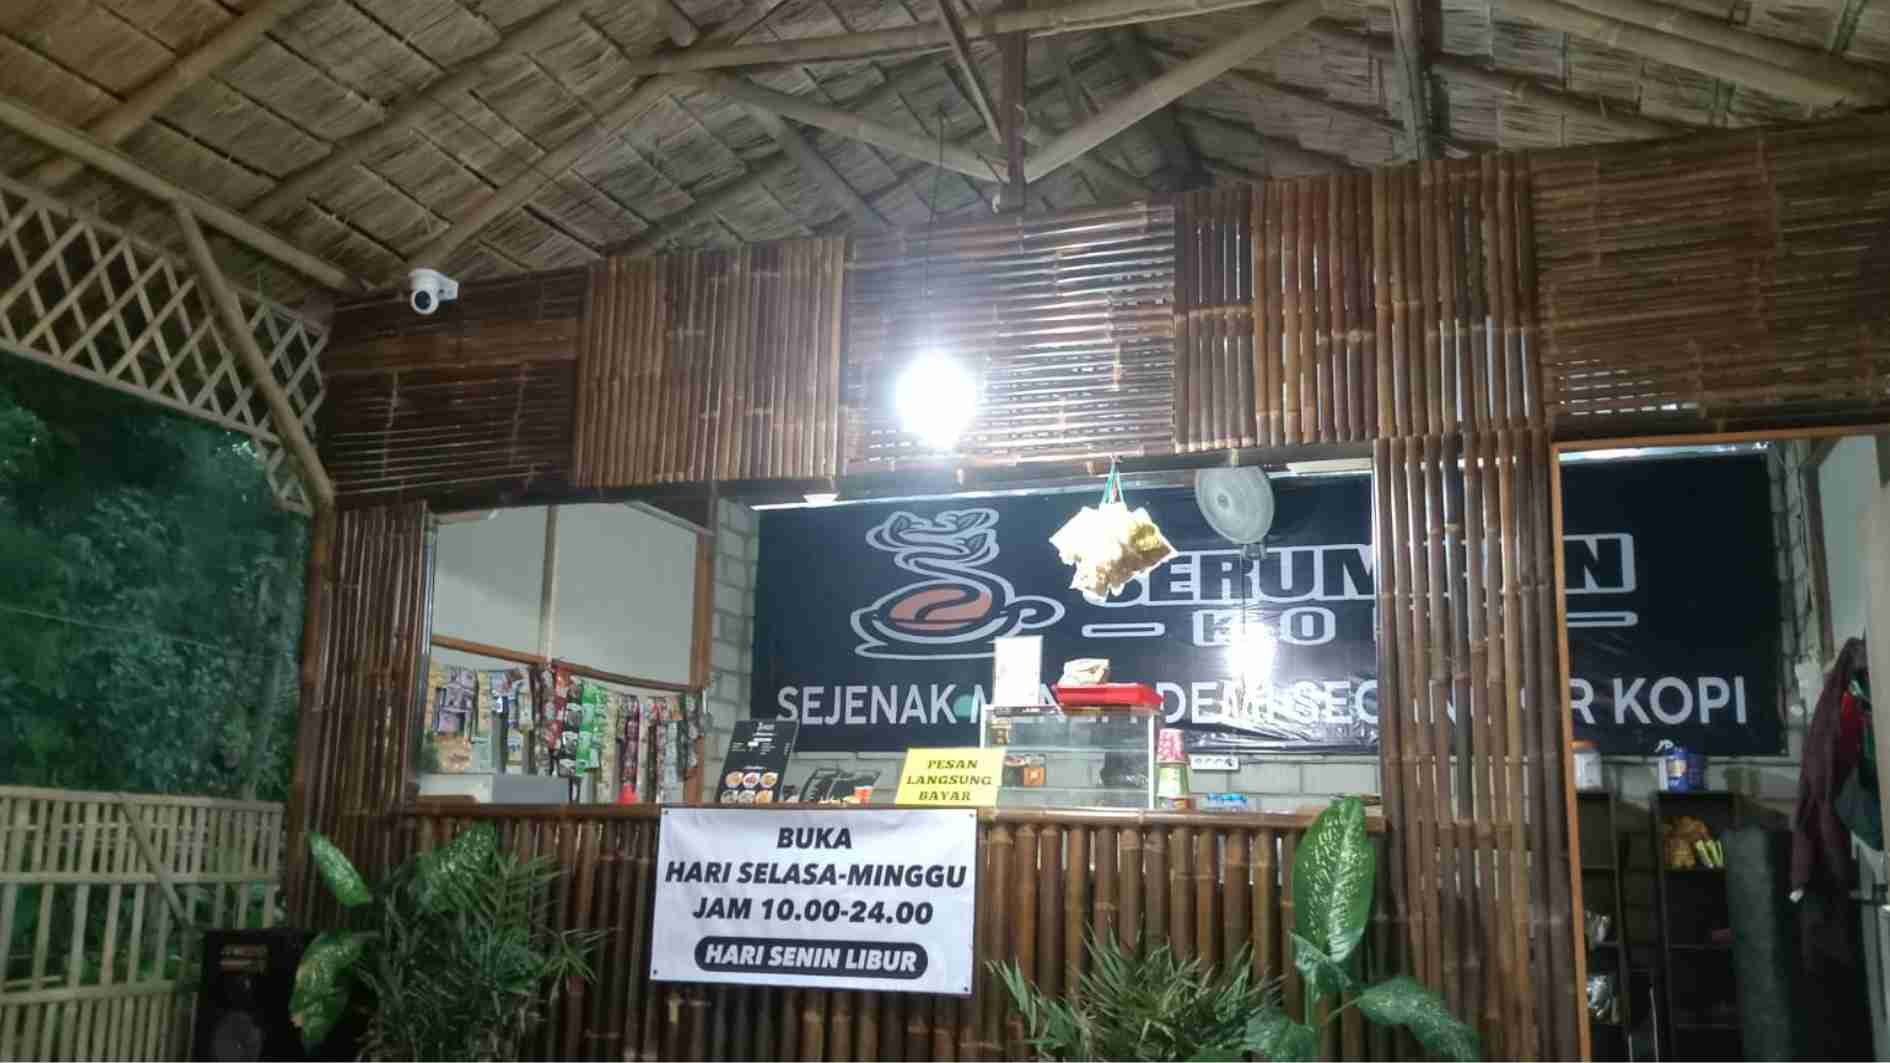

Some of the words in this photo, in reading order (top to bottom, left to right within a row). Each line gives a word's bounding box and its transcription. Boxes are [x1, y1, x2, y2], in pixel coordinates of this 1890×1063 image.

[775, 684, 957, 725] SEJENAK
[1613, 675, 1747, 725] KOPI
[927, 759, 978, 769] PESAN
[906, 775, 992, 786] LANGSUNG
[918, 791, 971, 801] BAYAR
[776, 826, 852, 850] BUKA
[665, 861, 732, 884] HARI
[735, 862, 967, 888] SELASA-MINGGU
[692, 897, 752, 920] JAM
[760, 898, 934, 925] 10.00-24.00
[704, 943, 765, 966] HARI
[767, 946, 842, 970] SENIN
[844, 949, 918, 973] LIBUR
